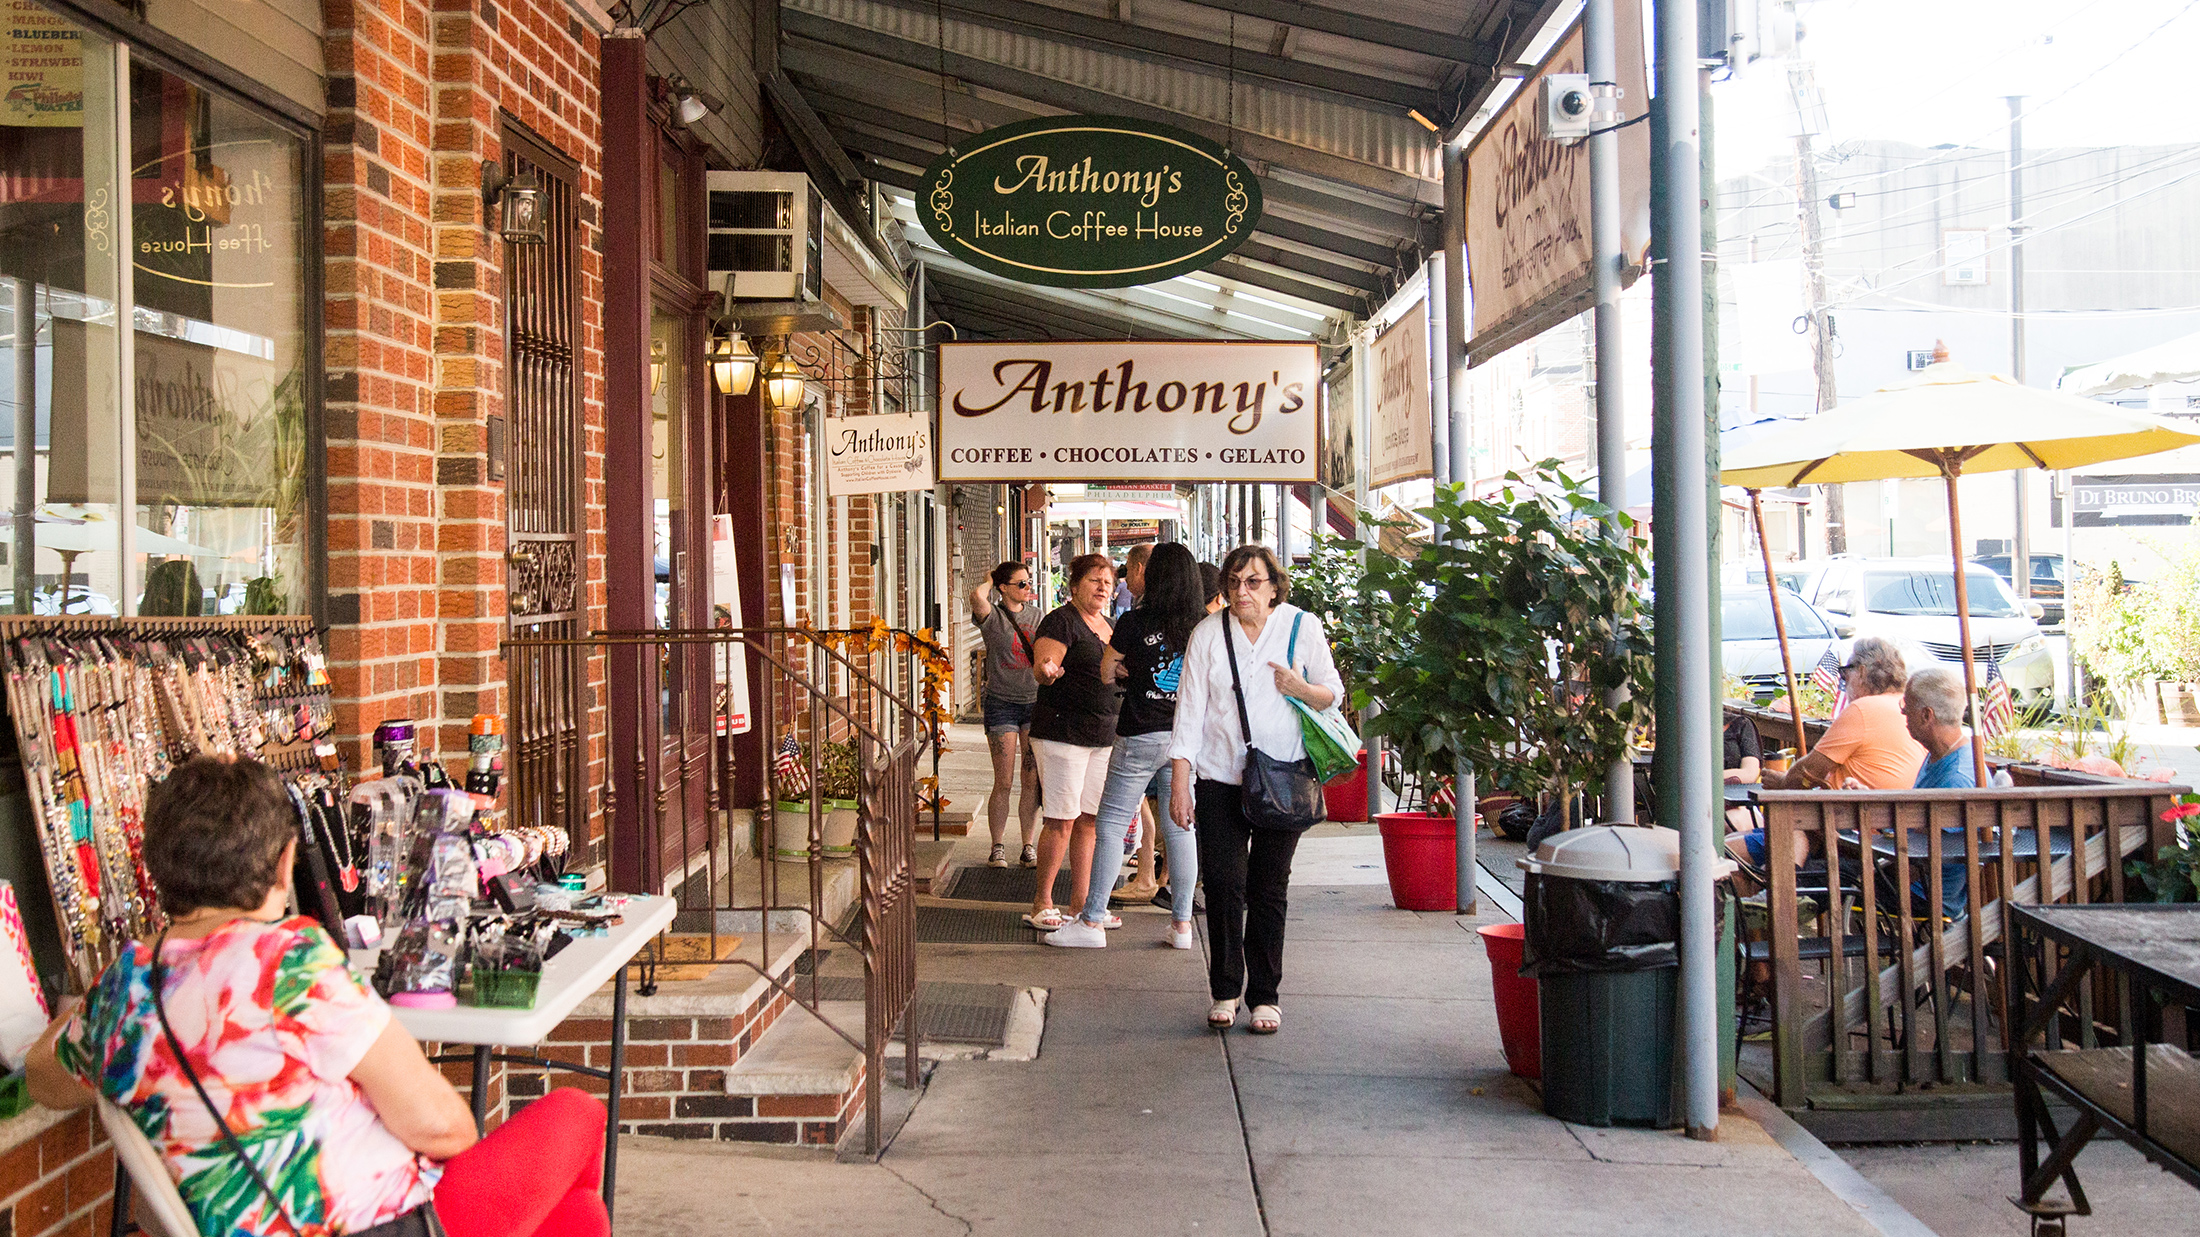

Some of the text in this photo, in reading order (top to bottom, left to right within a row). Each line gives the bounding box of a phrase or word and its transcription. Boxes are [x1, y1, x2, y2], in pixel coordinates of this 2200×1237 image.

[12, 29, 81, 39] BLUEBER
[12, 44, 63, 53] LEMON
[12, 57, 82, 67] STRAWBE
[8, 72, 44, 80] KIWI
[994, 154, 1183, 208] Anthony's
[974, 209, 1204, 241] Italian Coffee House
[952, 359, 1305, 435] Anthony's
[831, 428, 926, 460] Anthony's
[951, 446, 1306, 465] COFFEE CHOCOLATES GELATO
[1087, 491, 1172, 499] PHILADELPHIA
[2104, 489, 2169, 505] BRUNO
[2172, 488, 2200, 505] BR
